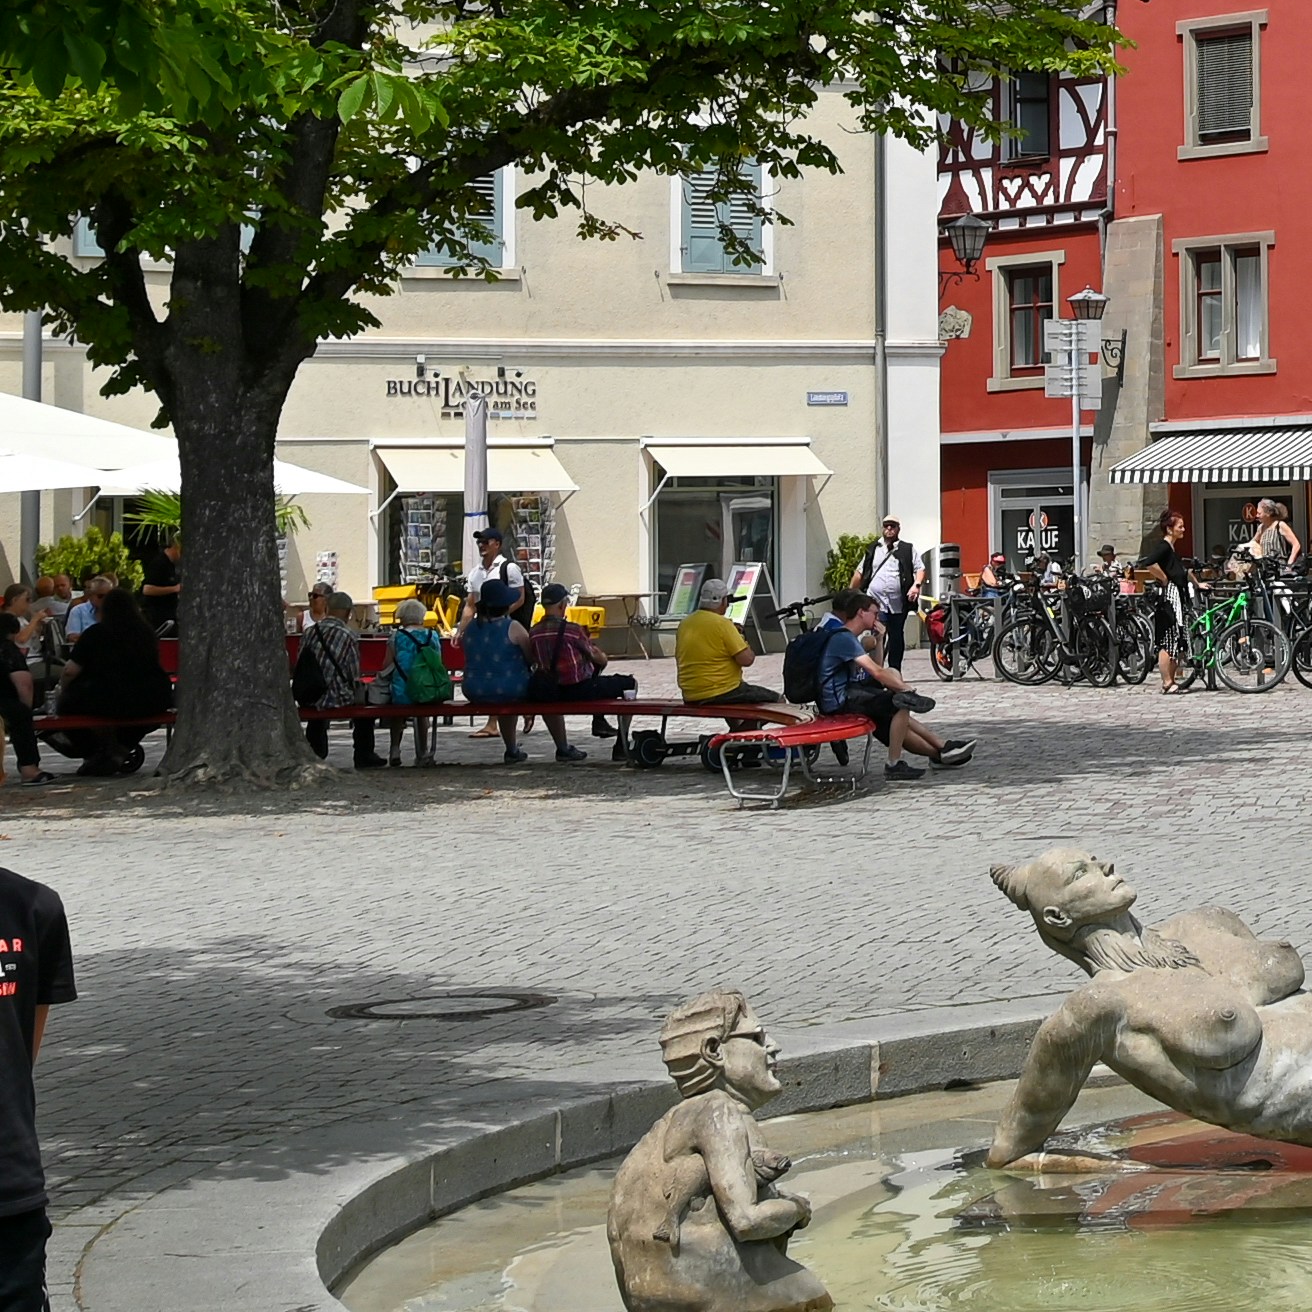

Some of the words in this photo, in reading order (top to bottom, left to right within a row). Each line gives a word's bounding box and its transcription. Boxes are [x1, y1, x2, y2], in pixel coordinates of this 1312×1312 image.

[492, 399, 511, 410] am
[515, 397, 537, 410] See
[1246, 506, 1253, 520] K
[1017, 531, 1059, 548] KAUF
